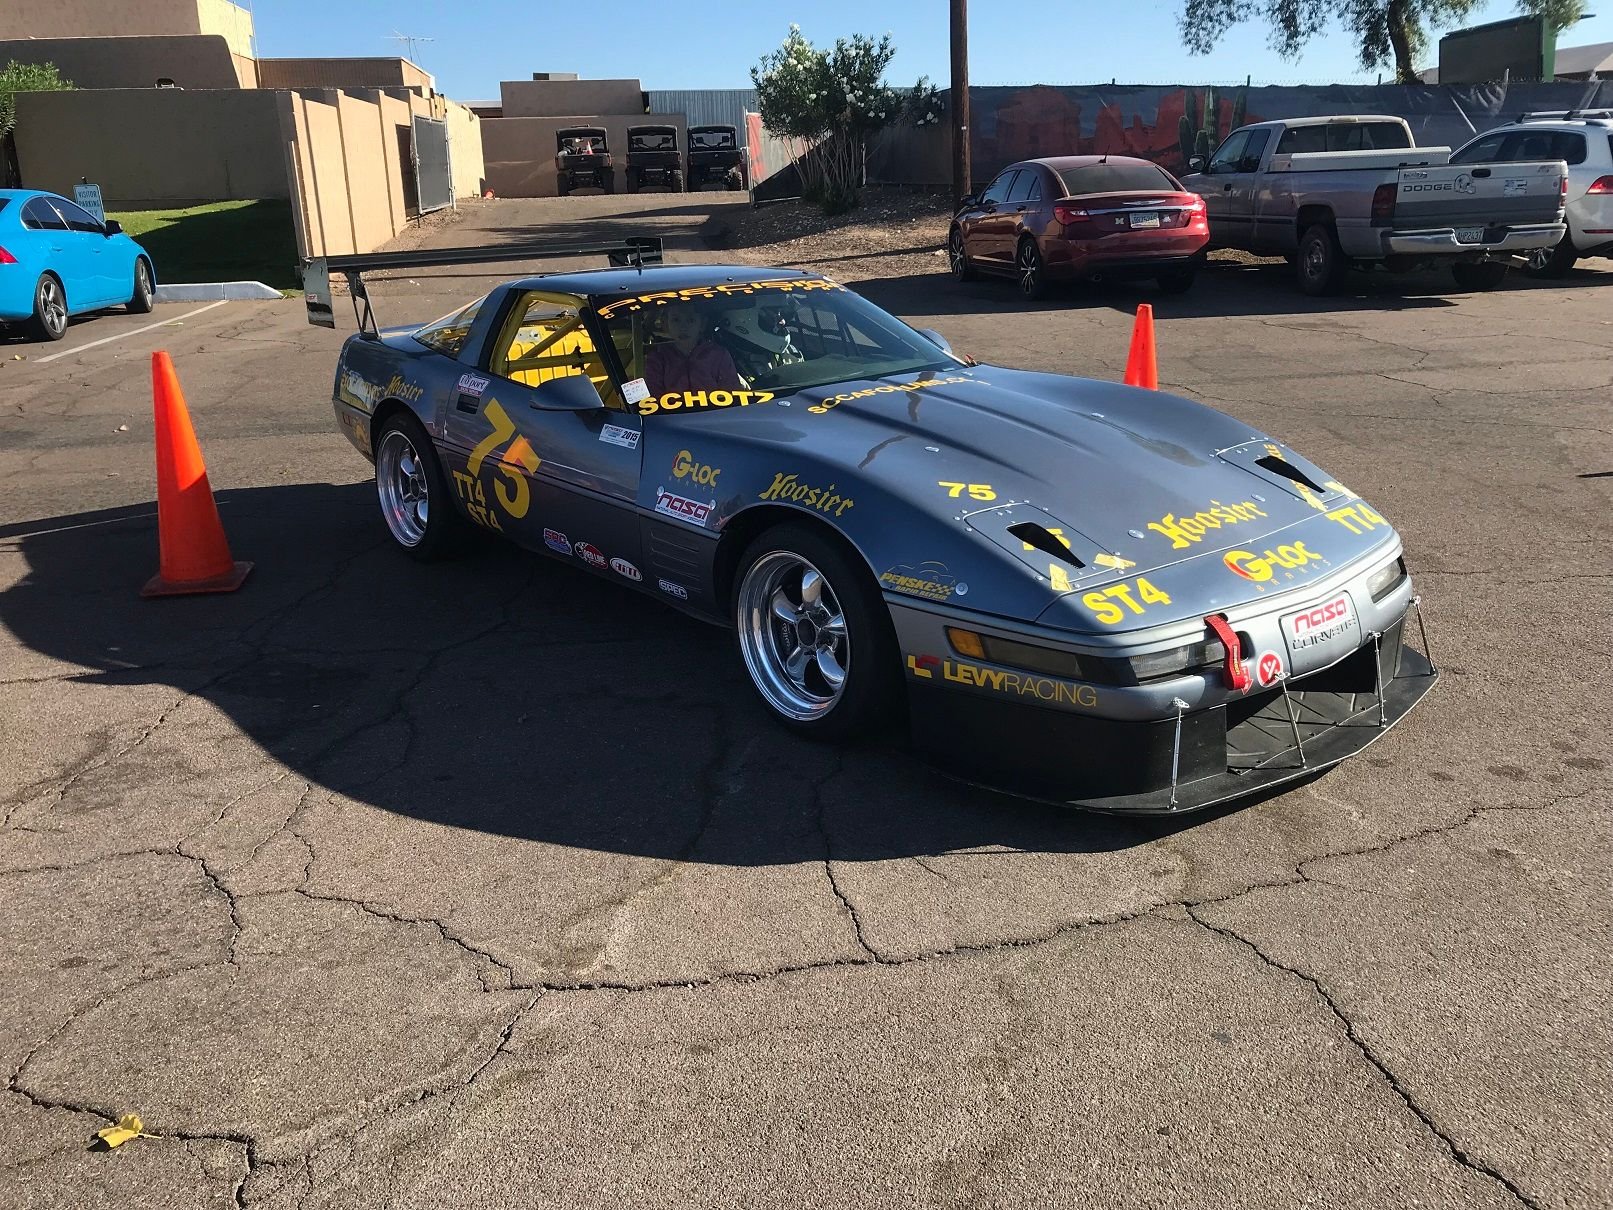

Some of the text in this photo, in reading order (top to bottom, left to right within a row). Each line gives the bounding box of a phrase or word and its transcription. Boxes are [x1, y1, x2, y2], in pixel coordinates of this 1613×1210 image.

[78, 190, 97, 198] VISITOR
[1403, 183, 1452, 193] DODGE
[638, 390, 775, 416] SCHOTZ
[621, 430, 640, 442] 2015
[466, 397, 542, 519] 75
[452, 469, 486, 507] TT4
[758, 472, 854, 517] Hoosier
[937, 480, 998, 501] 75
[467, 502, 504, 534] ST4
[658, 493, 710, 520] nasa
[1324, 503, 1389, 535] TT4
[1147, 499, 1268, 550] Hoosier
[660, 581, 687, 598] SPEC
[880, 572, 937, 592] PENSKE
[1082, 577, 1173, 625] ST4
[1294, 599, 1348, 634] nasa
